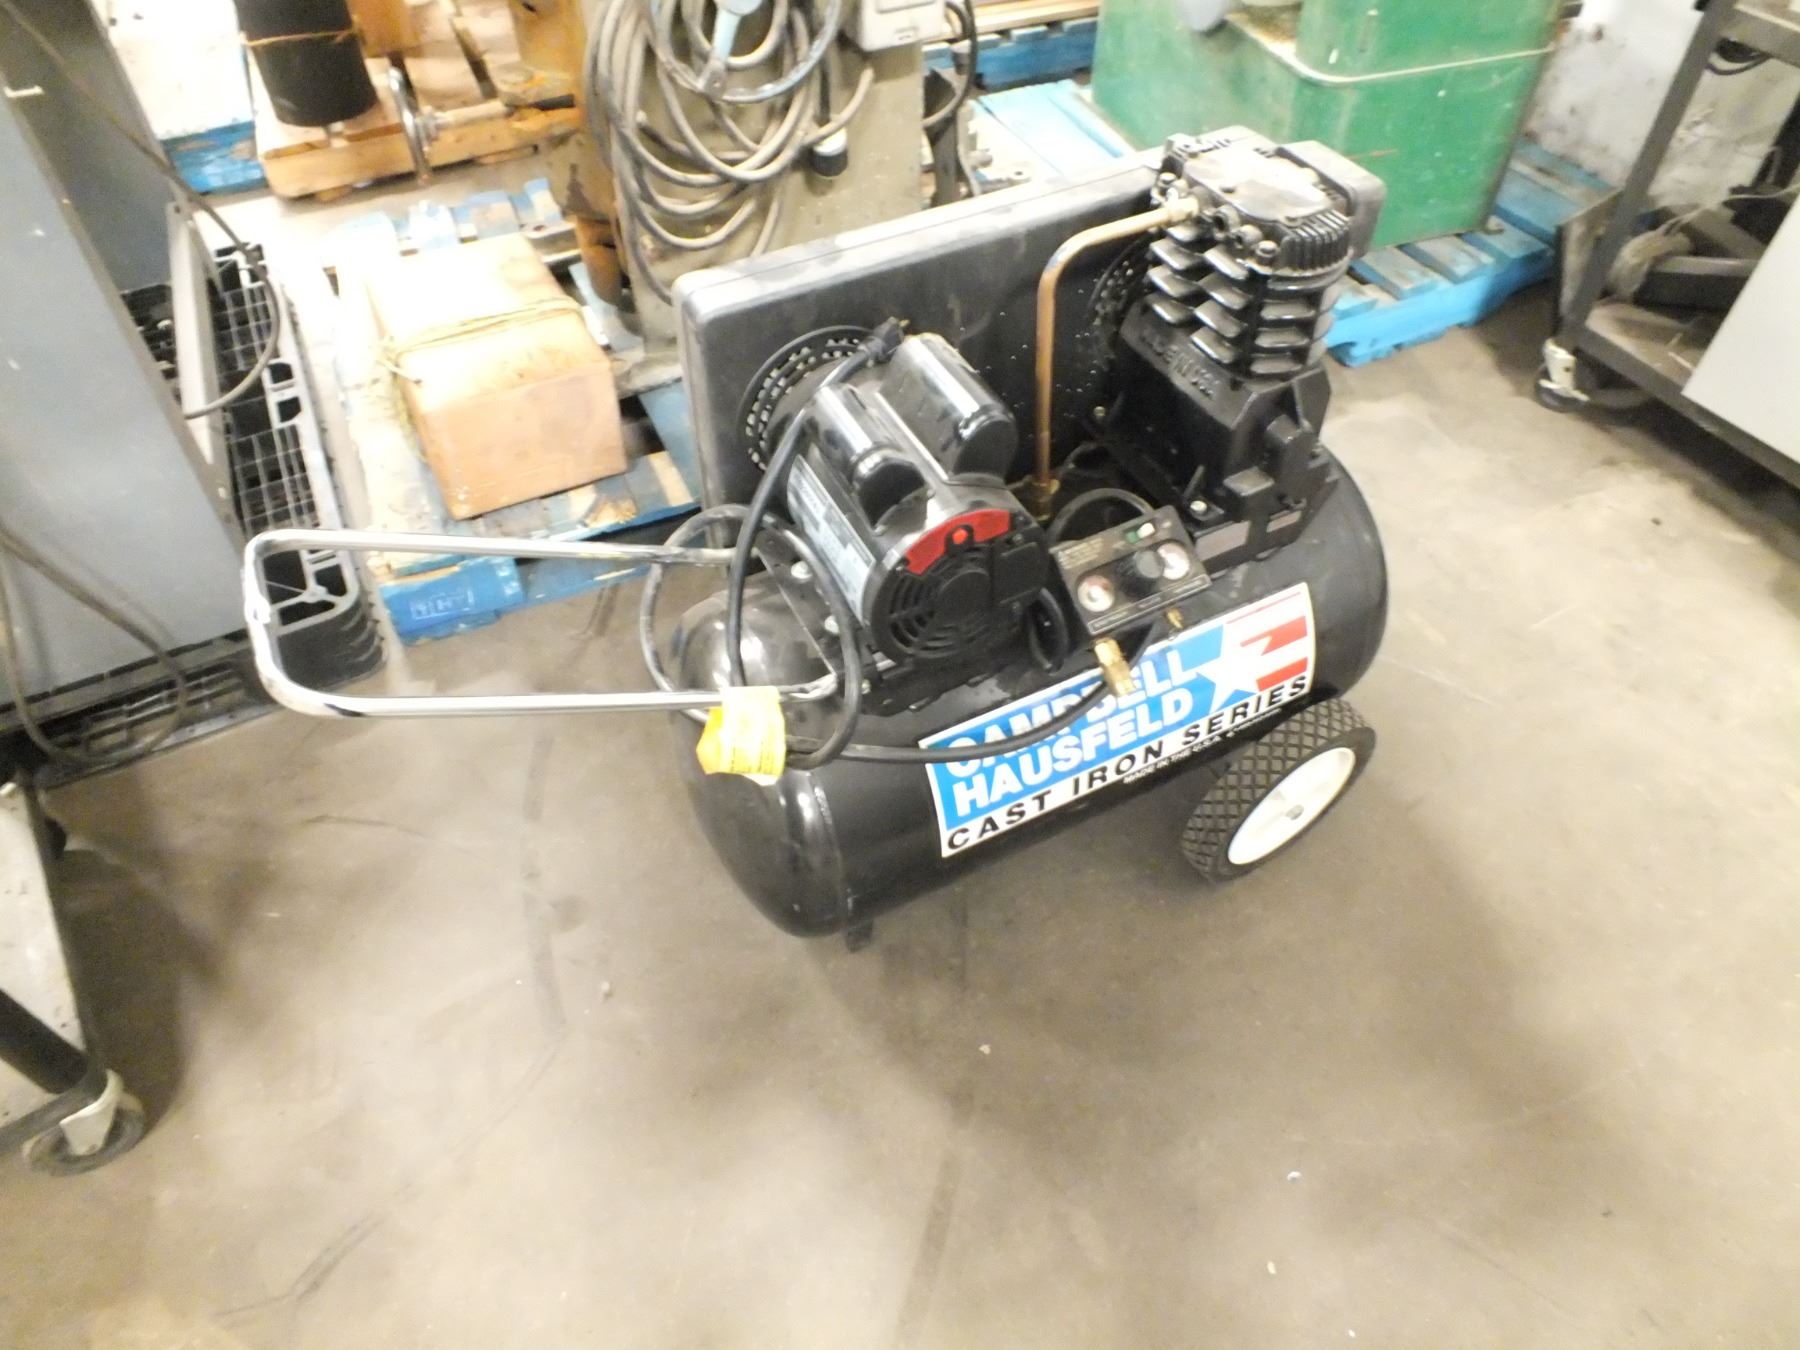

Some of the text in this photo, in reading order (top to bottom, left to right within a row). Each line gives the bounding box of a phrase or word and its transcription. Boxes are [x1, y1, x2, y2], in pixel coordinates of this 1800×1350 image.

[947, 789, 1052, 850] CAST
[1072, 740, 1163, 796] IRON
[1181, 675, 1306, 746] SERIES
[951, 687, 1193, 818] HAUSFELD
[1122, 763, 1155, 784] MADE
[1156, 757, 1170, 770] IN
[1171, 748, 1192, 762] THE
